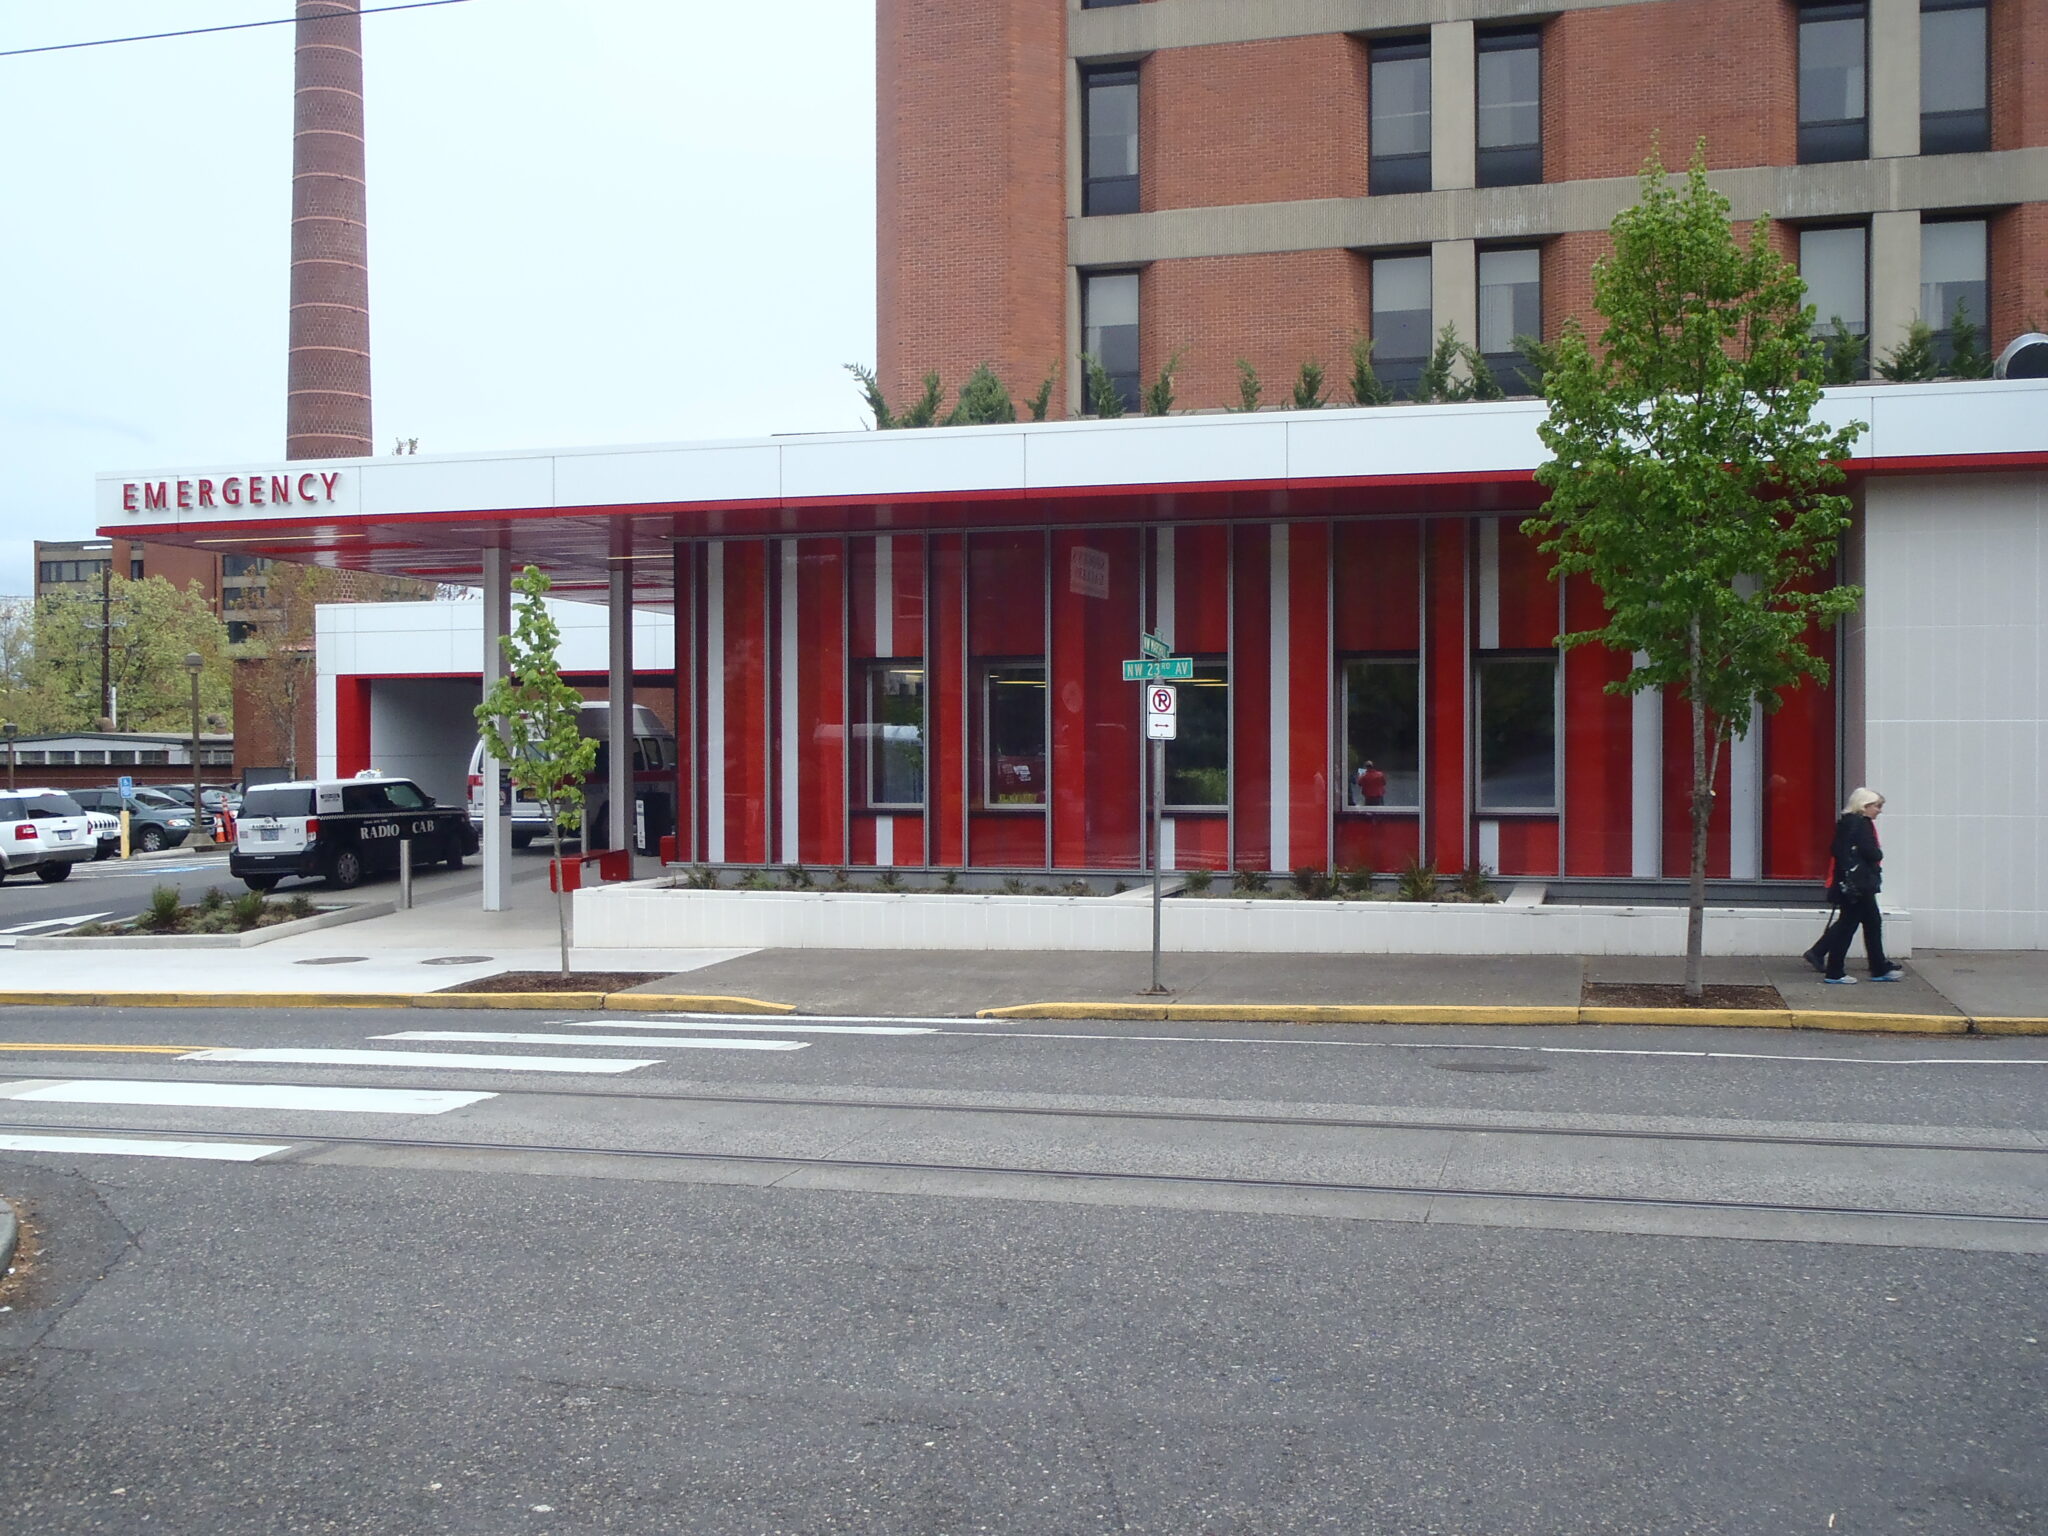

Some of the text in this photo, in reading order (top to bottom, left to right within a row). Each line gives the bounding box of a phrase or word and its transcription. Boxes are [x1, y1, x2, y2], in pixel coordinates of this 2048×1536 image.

[122, 472, 341, 511] EMERGENCY
[1127, 664, 1143, 677] NW
[1175, 662, 1189, 676] AV
[360, 820, 435, 840] RADIO CAB
